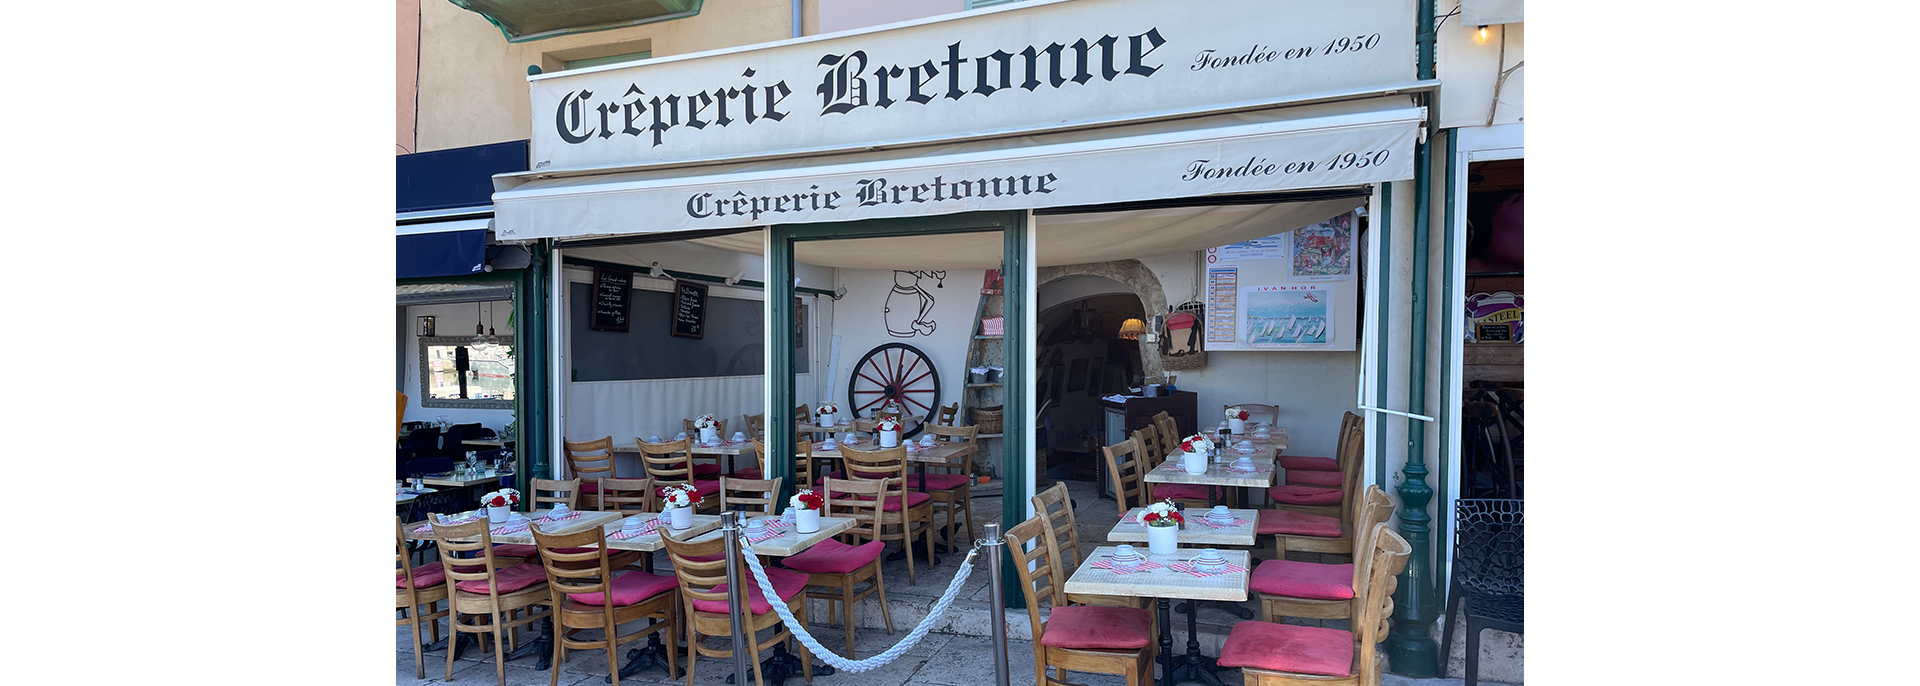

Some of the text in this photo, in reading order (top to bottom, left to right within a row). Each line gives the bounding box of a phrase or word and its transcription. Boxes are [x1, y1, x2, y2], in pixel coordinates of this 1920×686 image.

[1190, 33, 1381, 71] Fondée en 1950
[555, 26, 1168, 147] Crêperie Bretonne
[1181, 149, 1391, 182] Fondée en 1950
[686, 172, 1058, 221] Crêperie Bretonne
[1474, 310, 1520, 324] ASTEEL
